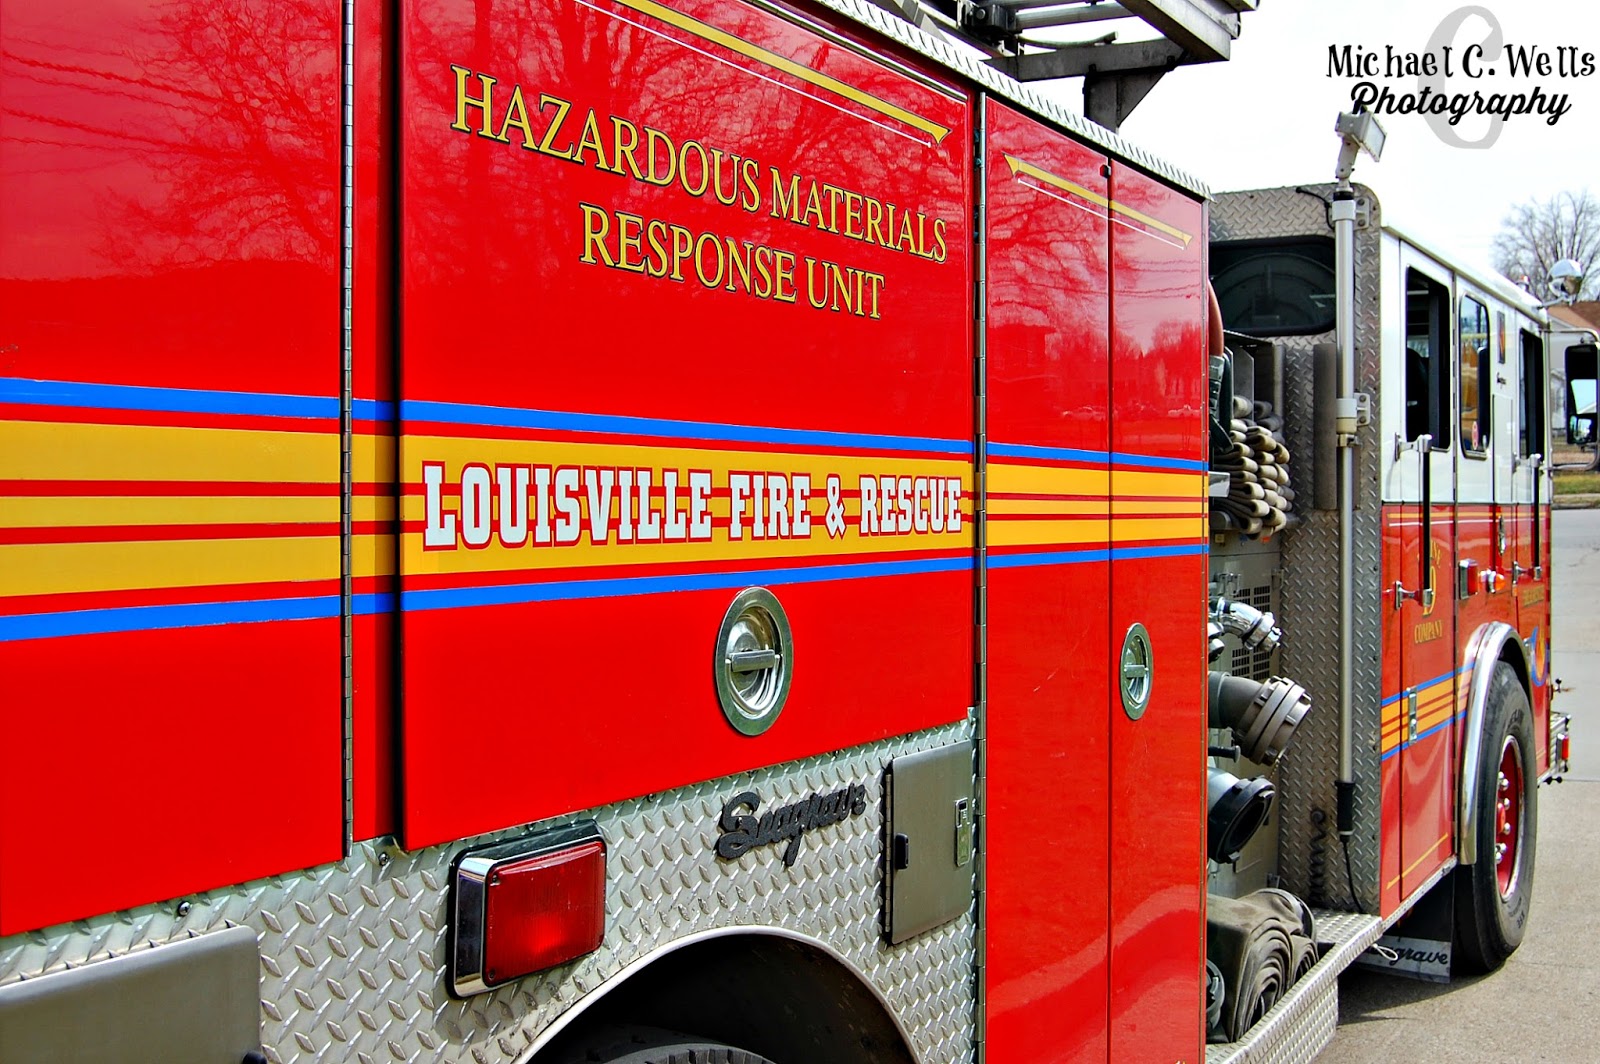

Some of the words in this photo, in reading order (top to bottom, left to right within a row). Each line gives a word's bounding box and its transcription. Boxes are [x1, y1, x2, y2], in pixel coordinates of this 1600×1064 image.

[450, 64, 762, 213] HAZARDOUS
[769, 167, 948, 264] MATERIALS
[578, 203, 797, 304] RESPONSE
[804, 256, 886, 320] UNIT
[422, 460, 713, 551] LOUISVILLE
[728, 470, 812, 541] FIRE
[825, 473, 848, 539] &
[859, 474, 963, 536] RESCUE
[1414, 619, 1443, 644] COMPANY
[717, 783, 867, 867] Seagrave
